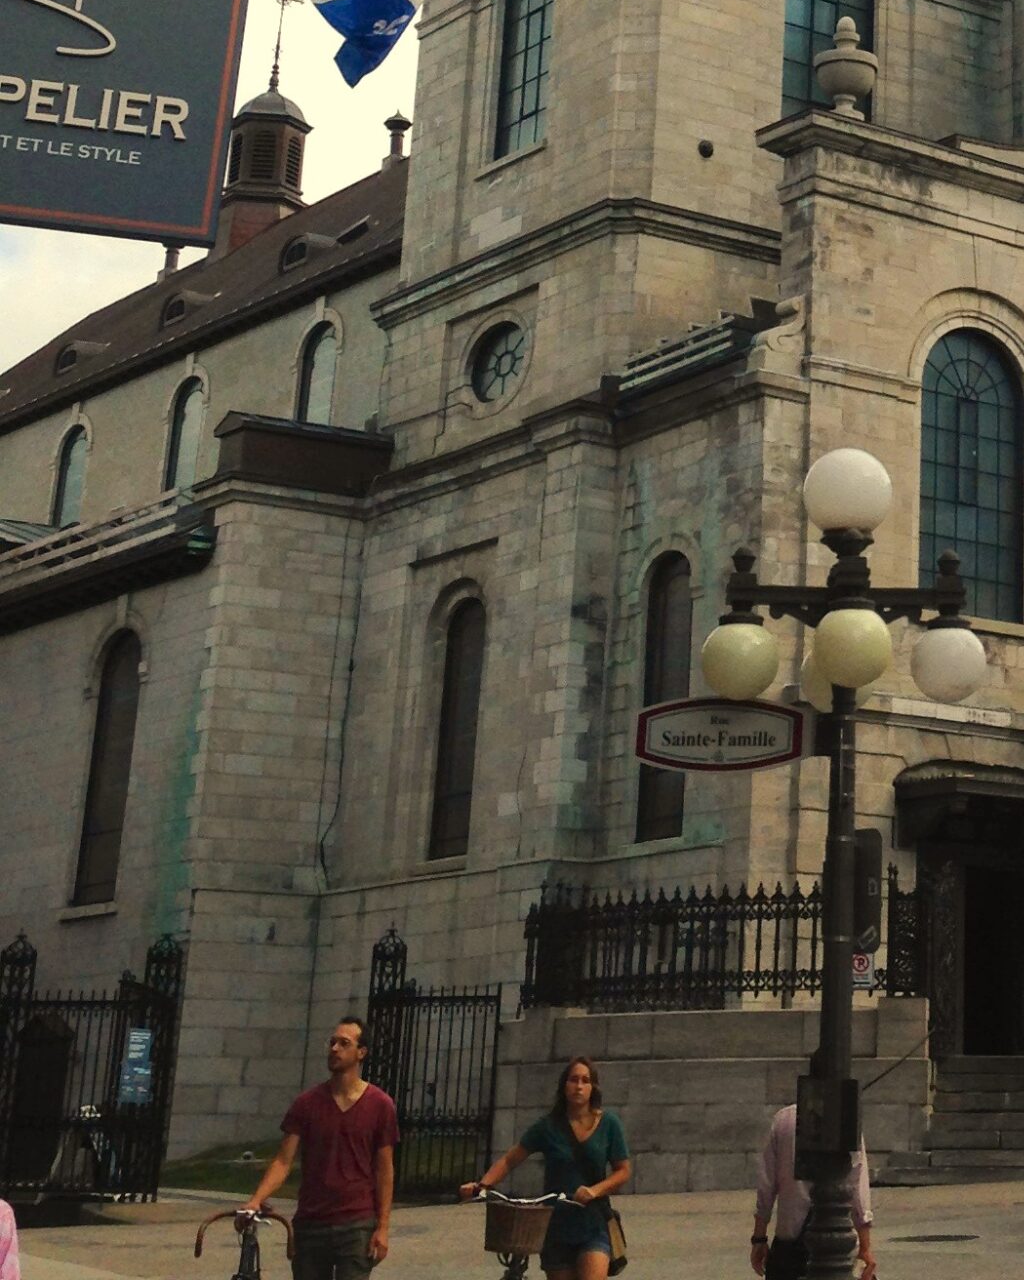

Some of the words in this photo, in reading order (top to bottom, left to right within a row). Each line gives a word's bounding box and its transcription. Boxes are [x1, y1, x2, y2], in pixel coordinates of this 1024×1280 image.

[16, 136, 43, 153] ET
[47, 140, 74, 157] LE
[77, 144, 142, 165] STYLE
[710, 715, 729, 725] Rue
[661, 729, 777, 747] Sainte-Famille
